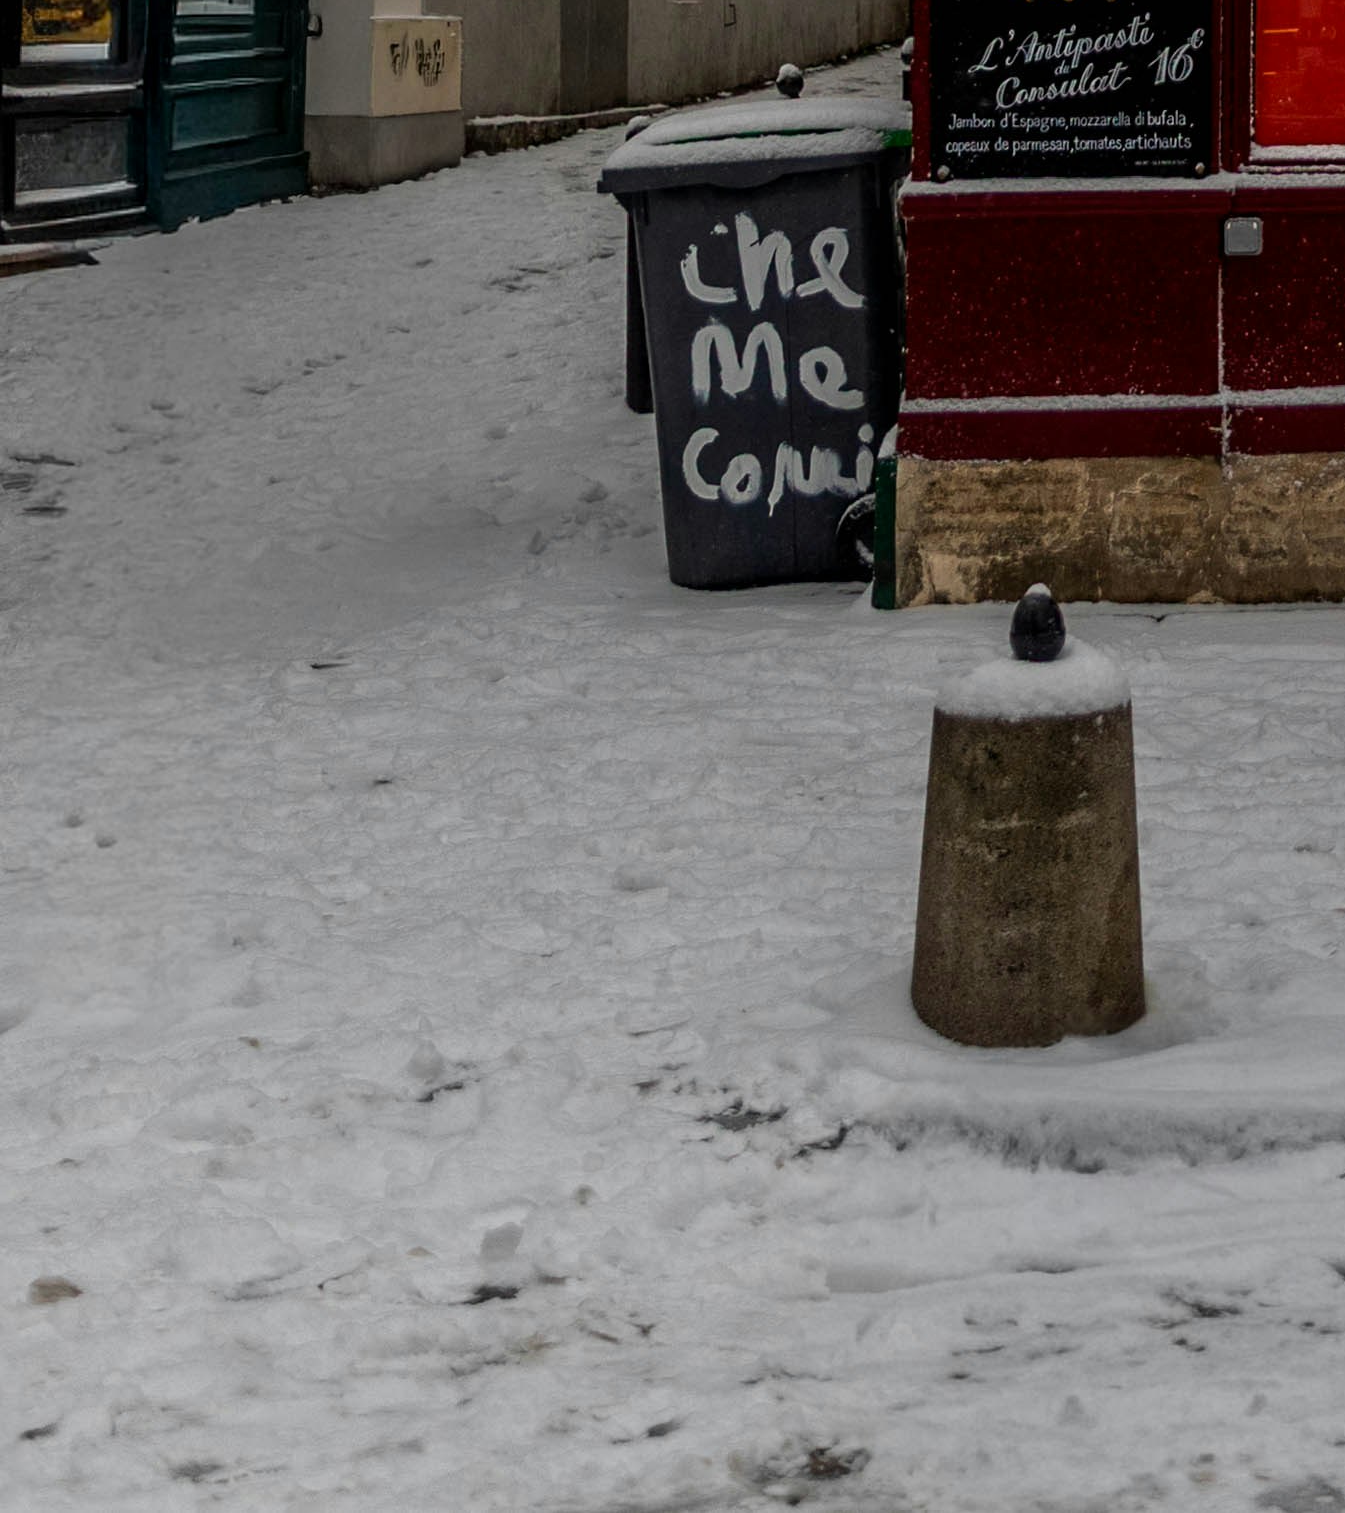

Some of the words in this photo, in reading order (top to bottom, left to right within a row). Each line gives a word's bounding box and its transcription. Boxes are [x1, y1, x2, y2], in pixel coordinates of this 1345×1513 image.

[968, 12, 1155, 74] L'Antipasti
[1055, 60, 1070, 76] du
[995, 62, 1132, 110] Consulat
[949, 113, 995, 130] Jambon
[1070, 112, 1131, 127] mozzarella
[1135, 111, 1145, 126] di
[946, 138, 989, 156] copeaux
[995, 138, 1009, 151] de
[1125, 133, 1192, 151] artichauts
[691, 316, 865, 411] Me
